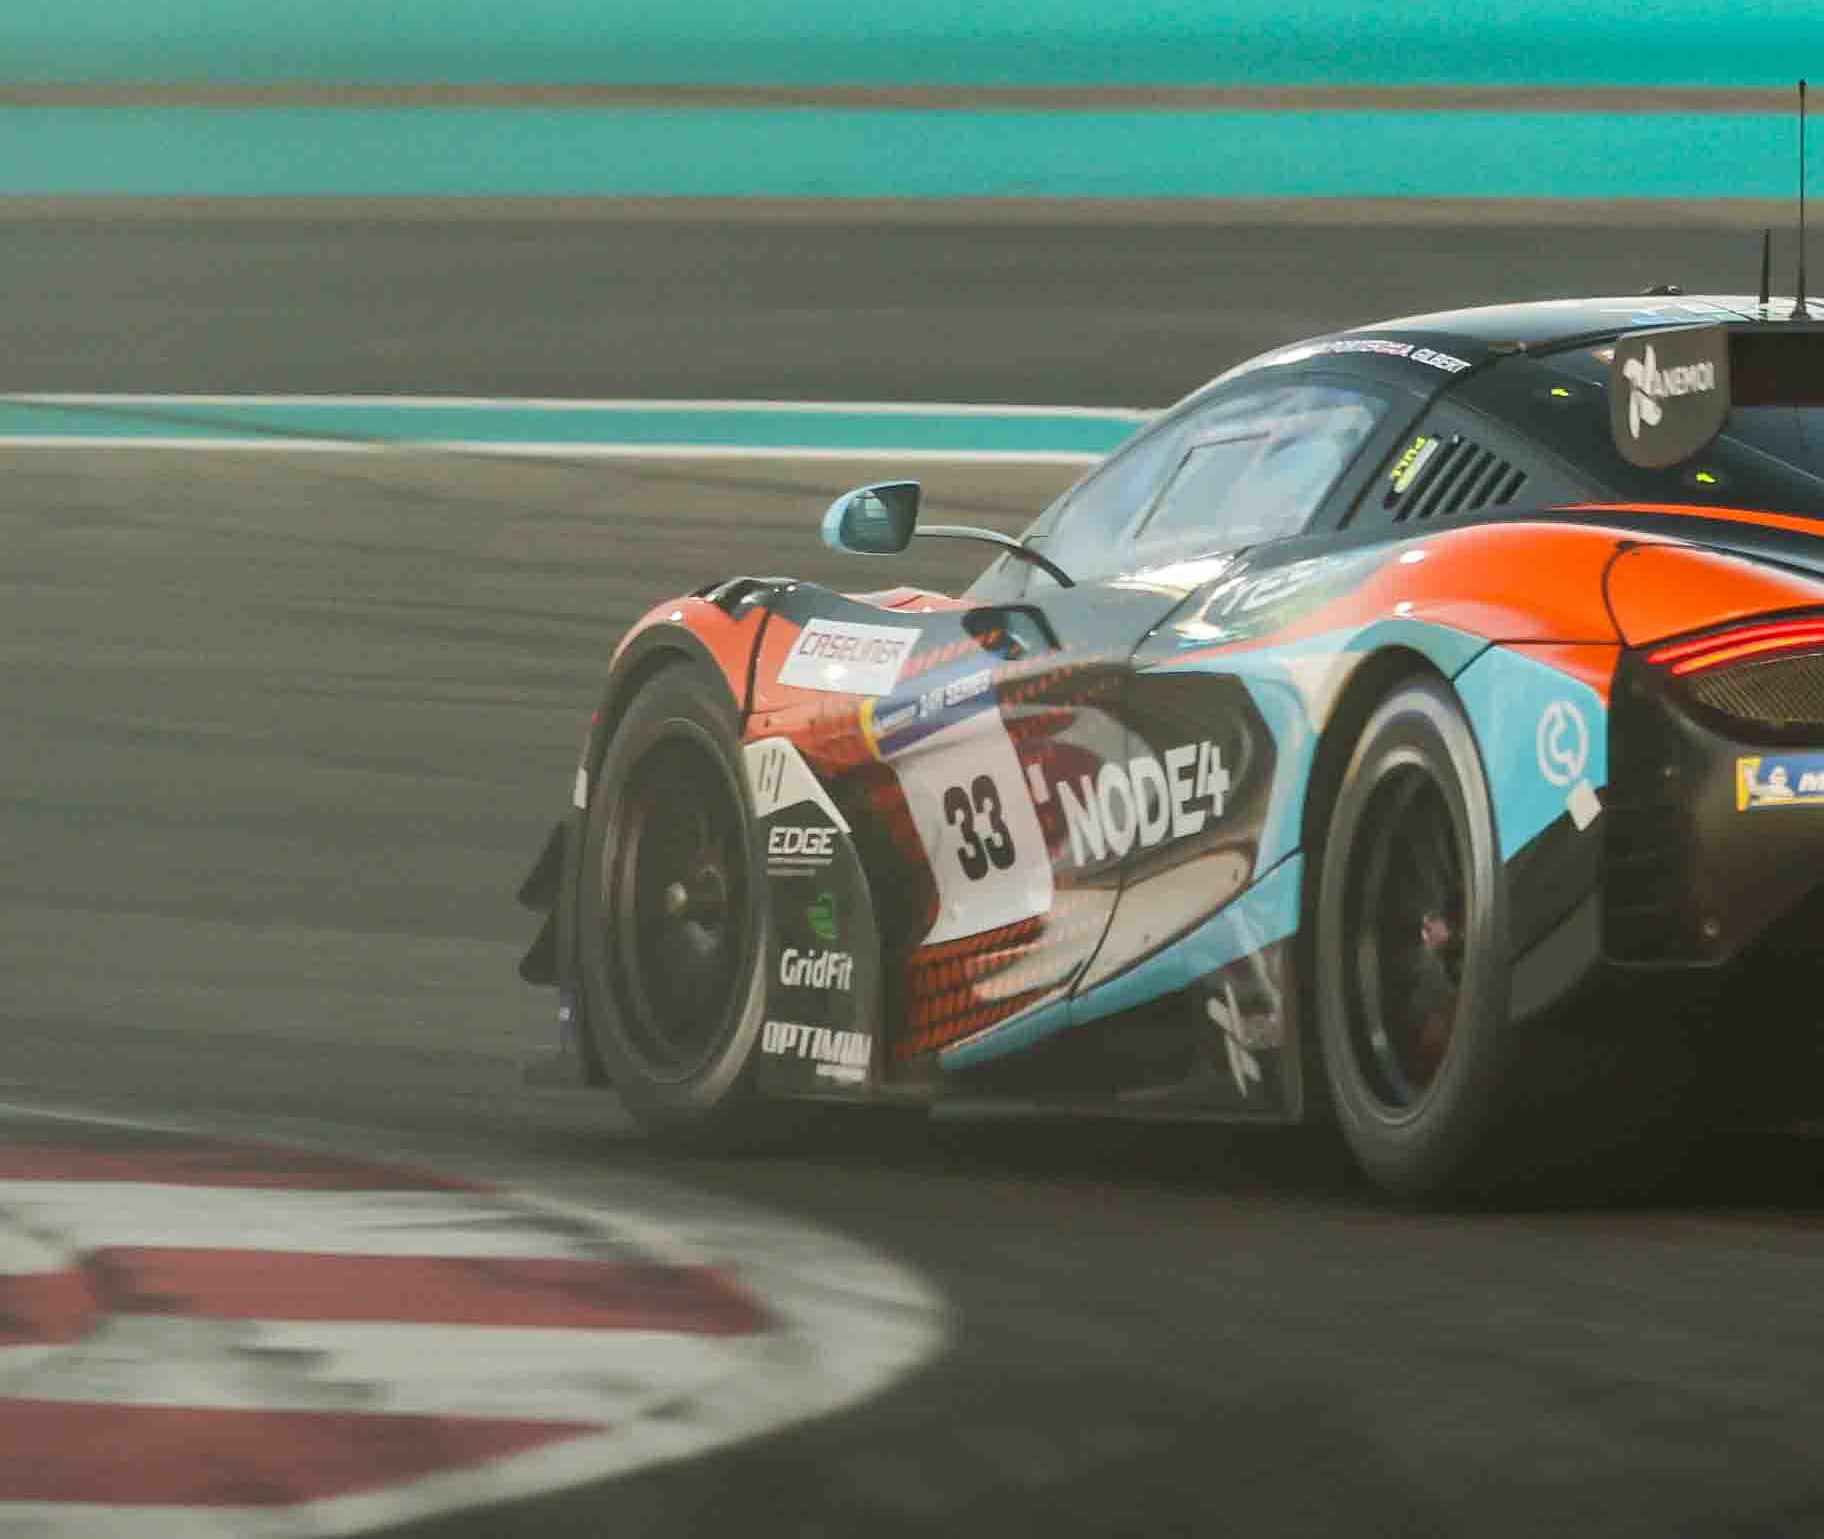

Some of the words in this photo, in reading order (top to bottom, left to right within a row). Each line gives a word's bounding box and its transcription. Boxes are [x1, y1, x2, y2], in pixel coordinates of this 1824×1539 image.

[768, 826, 838, 855] EDGE
[944, 774, 1016, 881] 33
[1056, 741, 1231, 867] NODE4
[780, 948, 853, 991] GridFit
